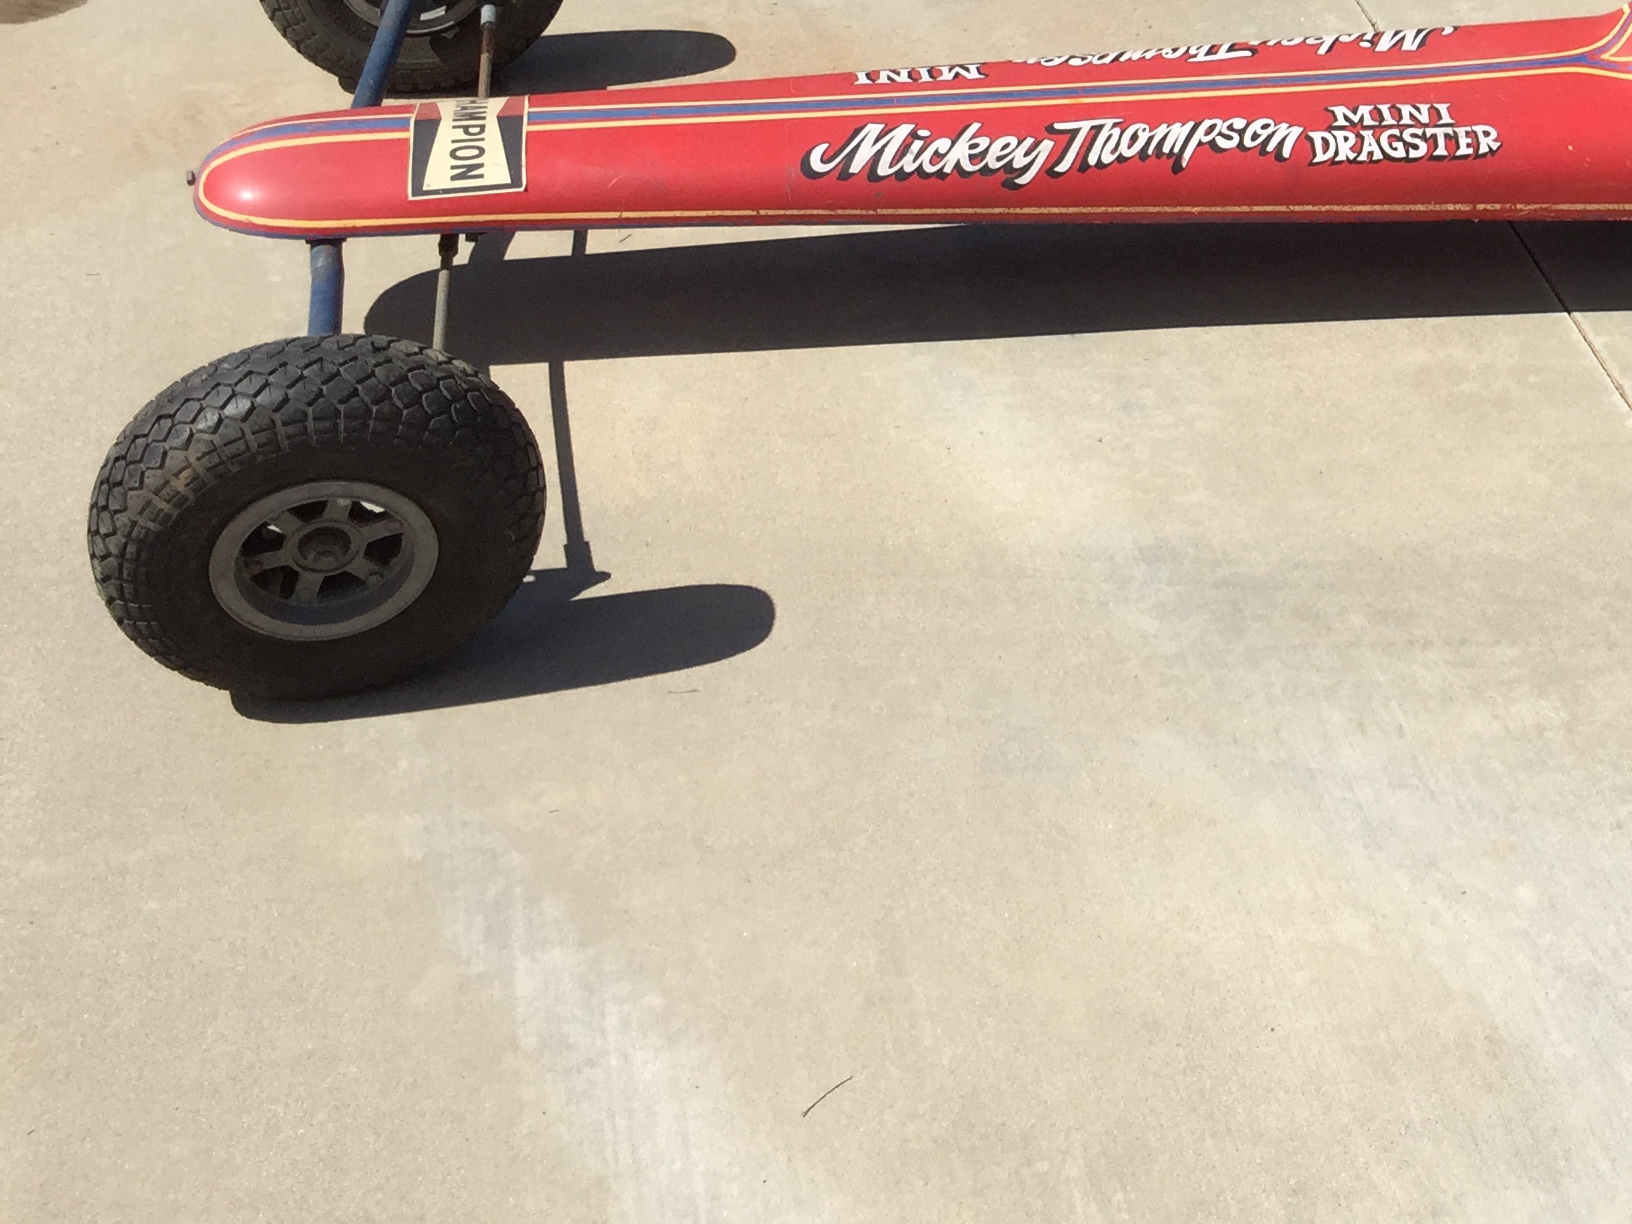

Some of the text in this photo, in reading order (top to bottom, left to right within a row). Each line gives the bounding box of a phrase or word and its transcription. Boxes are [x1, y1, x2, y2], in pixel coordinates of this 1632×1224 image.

[854, 63, 989, 85] MINI
[1324, 102, 1457, 129] MINI
[801, 117, 1305, 190] Mickey Thompson
[1305, 124, 1503, 167] DRAGSTER
